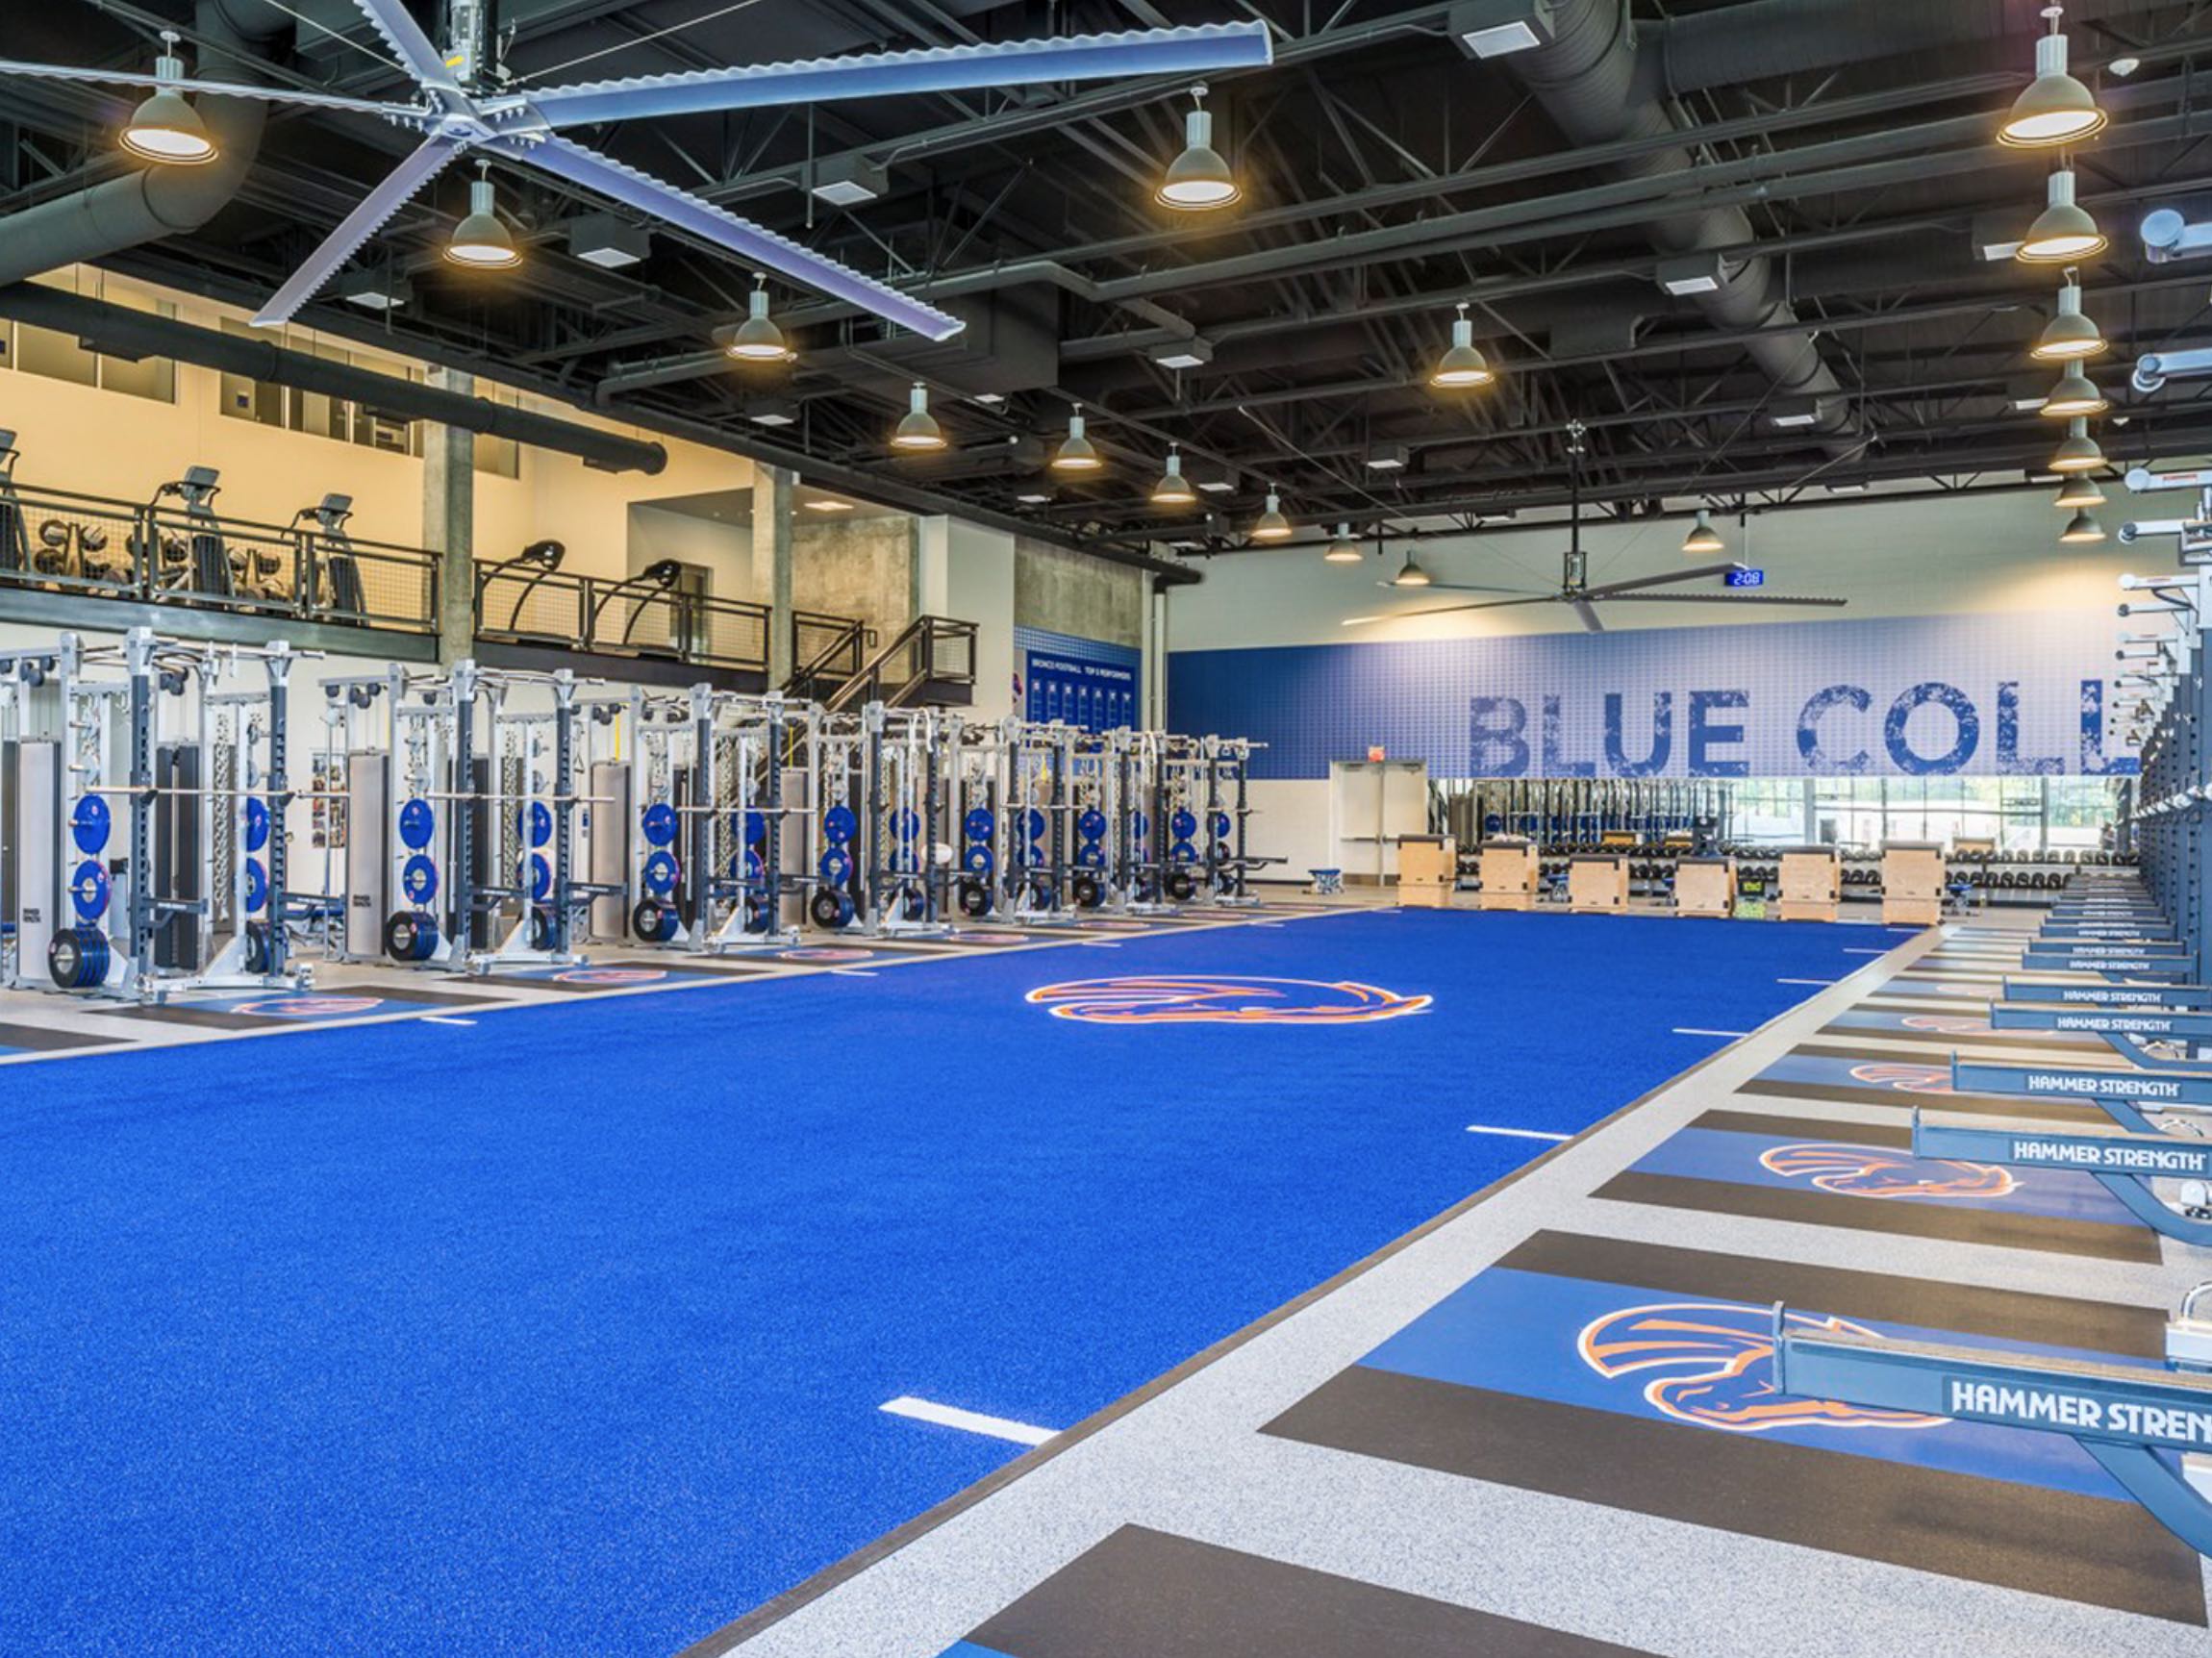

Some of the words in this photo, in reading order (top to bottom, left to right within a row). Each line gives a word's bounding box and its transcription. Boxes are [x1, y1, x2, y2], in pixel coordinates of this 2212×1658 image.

[1470, 689, 1749, 779] BLUE
[1796, 679, 2141, 776] COLL
[2063, 990, 2109, 1001] HAMMER
[2110, 992, 2162, 1003] STRENGTH
[2057, 1016, 2110, 1030] HAMMER
[2111, 1017, 2173, 1032] STRENGTH
[2028, 1074, 2097, 1093] HAMMER
[2100, 1079, 2180, 1097] STRENGTH
[2013, 1141, 2101, 1165] HAMMER
[2103, 1147, 2204, 1171] STRENGTH
[1951, 1380, 2102, 1429] HAMMER
